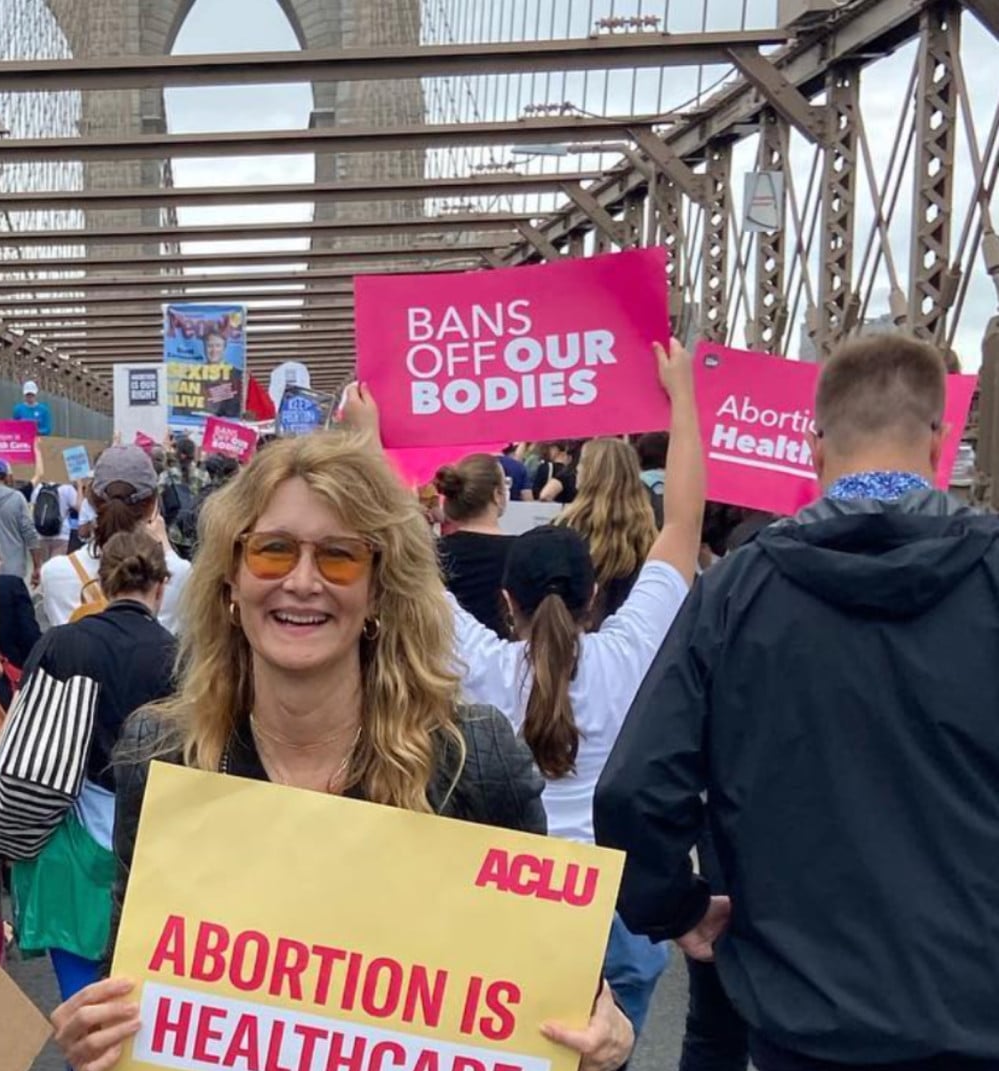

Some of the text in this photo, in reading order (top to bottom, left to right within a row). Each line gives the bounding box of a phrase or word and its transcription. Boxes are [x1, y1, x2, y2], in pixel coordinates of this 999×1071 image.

[407, 300, 532, 341] BANS
[406, 329, 617, 378] OFF OUR
[130, 389, 156, 400] RIGHT
[411, 369, 598, 415] BODIES
[475, 848, 600, 907] ACLU
[148, 914, 522, 1041] ABORTION IS
